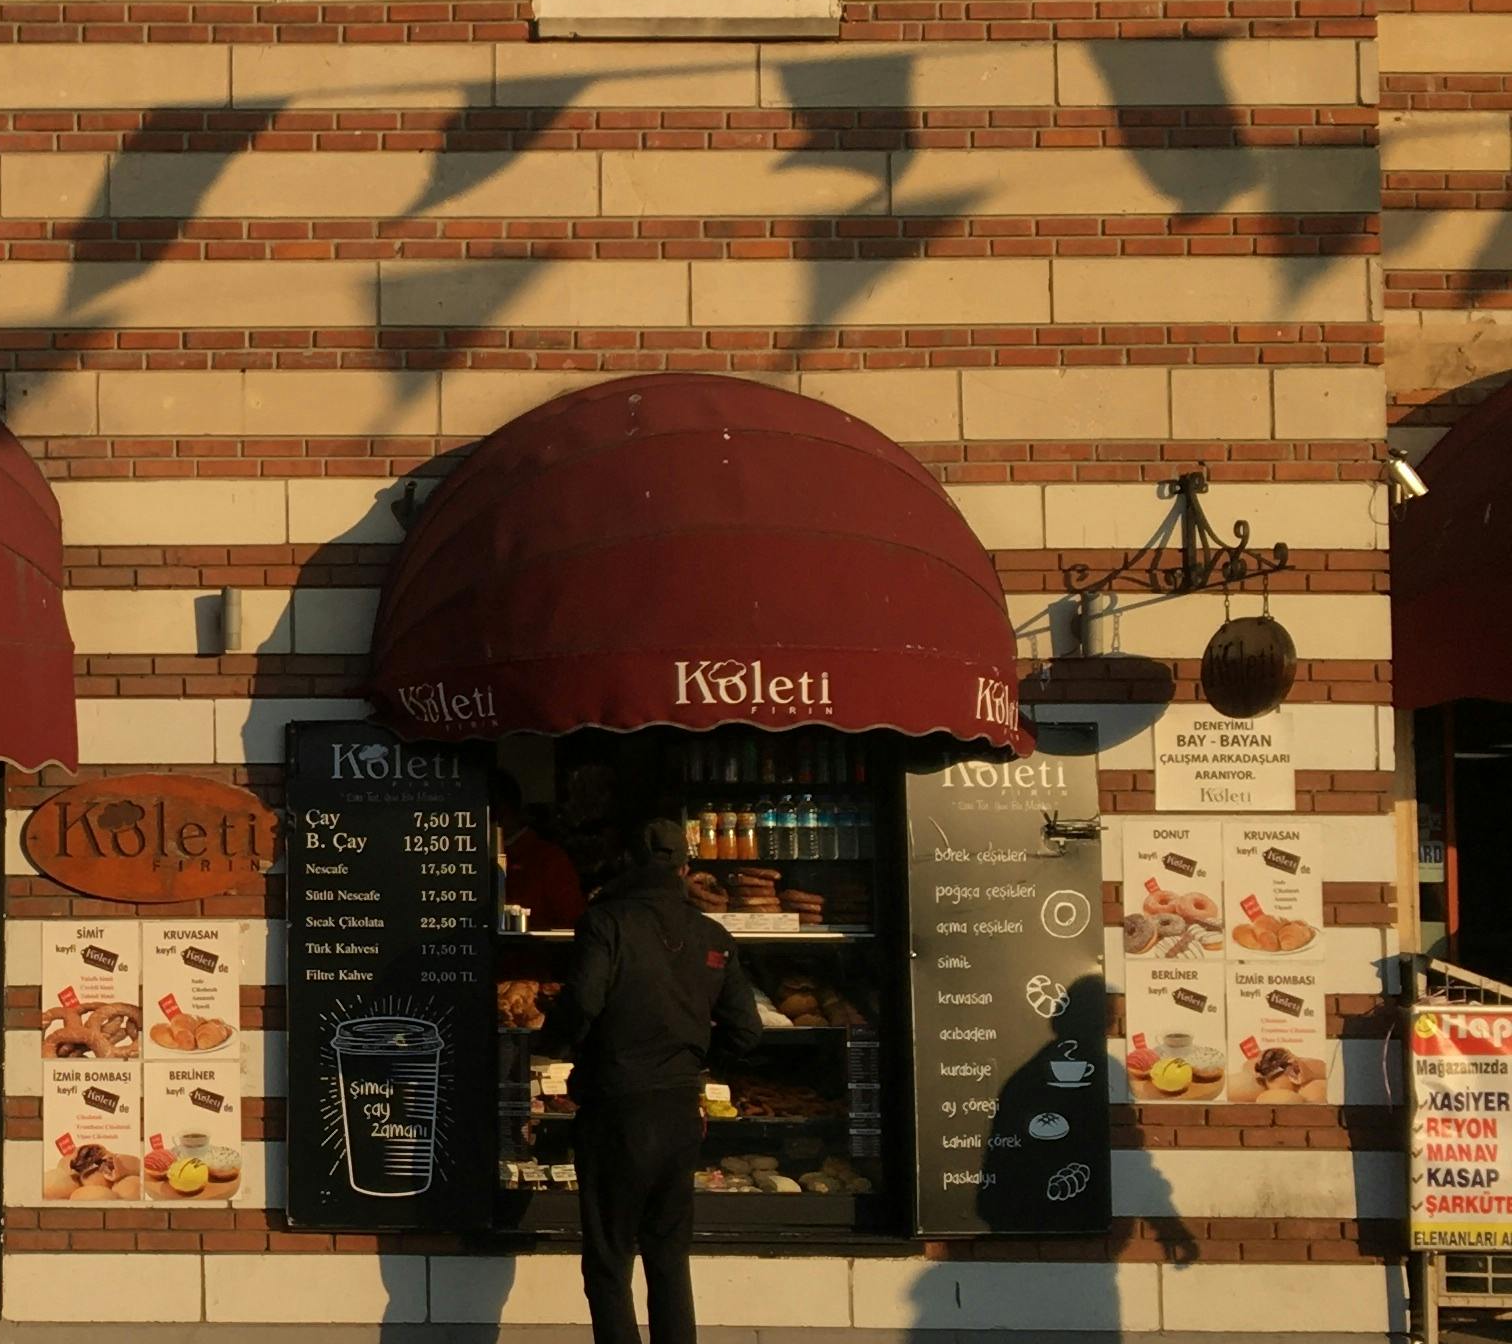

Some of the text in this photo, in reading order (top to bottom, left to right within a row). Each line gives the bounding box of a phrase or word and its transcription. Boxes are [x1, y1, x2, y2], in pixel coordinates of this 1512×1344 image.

[751, 706, 833, 715] FIRIN
[1194, 720, 1254, 731] DENEYİMLİ
[1176, 735, 1272, 748] BAY BAYAN
[1160, 754, 1290, 765] ÇALIŞMA ARKADAŞLARI
[1195, 770, 1256, 781] ARANIYOR.
[305, 809, 477, 831] Çay 7,50 TL
[1153, 830, 1190, 839] DONUT
[1244, 831, 1300, 841] KRUVASAN
[306, 833, 477, 855] B. Çay 12,50 TL
[976, 849, 1027, 865] çeşitleri
[153, 859, 261, 873] FIRIN
[305, 863, 477, 876] Nescafe 17,50 TL
[305, 890, 334, 901] Sütlü
[420, 891, 457, 903] 17,50
[460, 891, 477, 902] TL
[935, 883, 1036, 905] poğaça çeşitleri
[339, 915, 384, 930] Çikolata
[420, 917, 457, 930] 22,50
[460, 918, 477, 928] TL
[936, 919, 1024, 937] açma çeşitleri
[77, 926, 104, 939] SİMİT
[163, 930, 219, 940] KRUVASAN
[305, 942, 477, 957] Türk Kahvesi 17,50 TL
[937, 954, 972, 969] simit
[305, 969, 477, 984] Filtre Kahve 20,00 TL
[1151, 968, 1199, 980] BERLİNER
[1235, 972, 1264, 985] İZMİR
[938, 991, 993, 1006] kruvasan
[939, 1027, 997, 1042] acıbadem
[53, 1069, 81, 1081] İZMİR
[169, 1068, 215, 1080] BERLİNER
[940, 1062, 992, 1082] kurabiye
[1416, 1059, 1508, 1077] Mağazamızda
[363, 1102, 391, 1124] çay
[941, 1098, 1000, 1119] ay çöreği
[1426, 1117, 1497, 1138] REYON
[942, 1134, 1022, 1151] tahinli çörek
[1426, 1144, 1497, 1162] MANAV
[943, 1170, 996, 1191] paskalya
[1427, 1168, 1499, 1187] KASAP
[1414, 1231, 1497, 1246] ELEMANLARI
